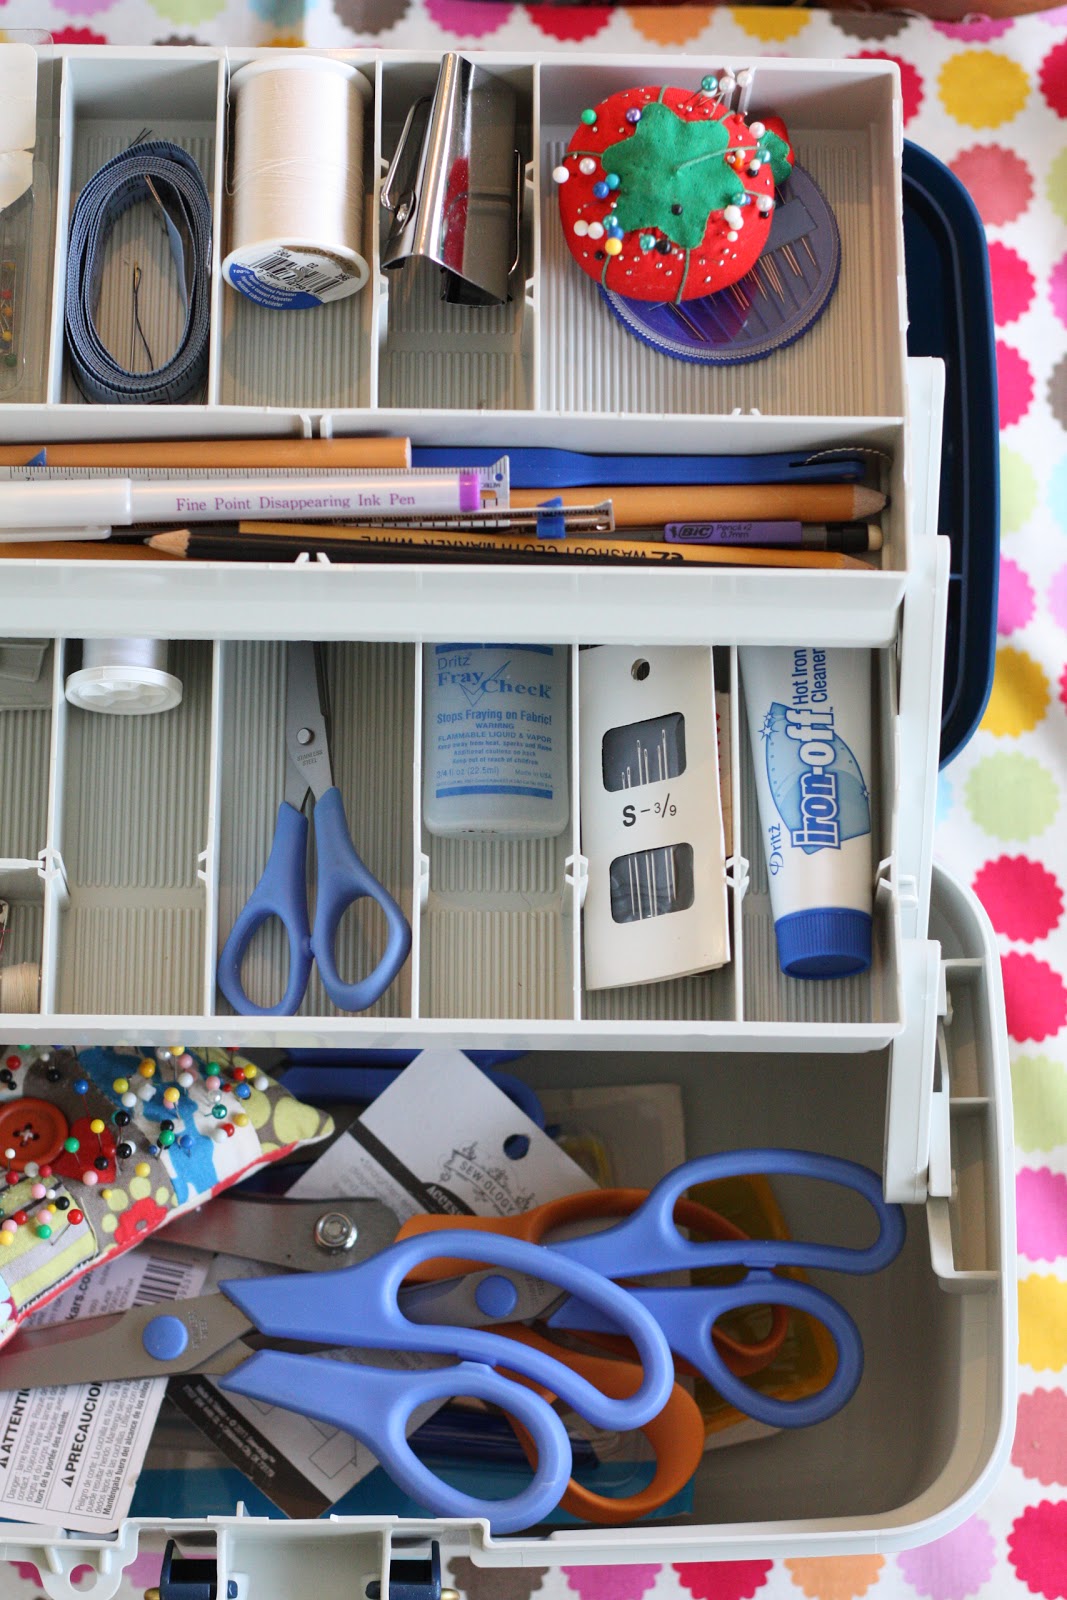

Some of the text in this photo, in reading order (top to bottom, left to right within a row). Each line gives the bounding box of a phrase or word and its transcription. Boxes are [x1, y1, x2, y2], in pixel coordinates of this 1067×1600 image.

[175, 492, 416, 511] Fine Point Disappearing Ink Pen
[720, 530, 749, 538] 0.7mm
[437, 671, 552, 698] Fray Check
[792, 648, 808, 705] Hot Iron
[812, 647, 827, 703] Cleaner
[436, 708, 552, 725] Stops Fraying on Fabric!
[438, 731, 486, 742] FLAMMABLE
[526, 733, 551, 743] VAPOR
[785, 708, 841, 849] iron-off
[767, 823, 784, 876] Dritz
[425, 1182, 460, 1219] ACCES
[131, 1409, 140, 1419] de
[122, 1419, 138, 1446] alcance
[119, 1445, 130, 1457] del
[34, 1488, 44, 1504] hors
[39, 1478, 47, 1488] de
[51, 1435, 61, 1448] des
[114, 1457, 126, 1475] fuera
[101, 1475, 122, 1516] Manténgala
